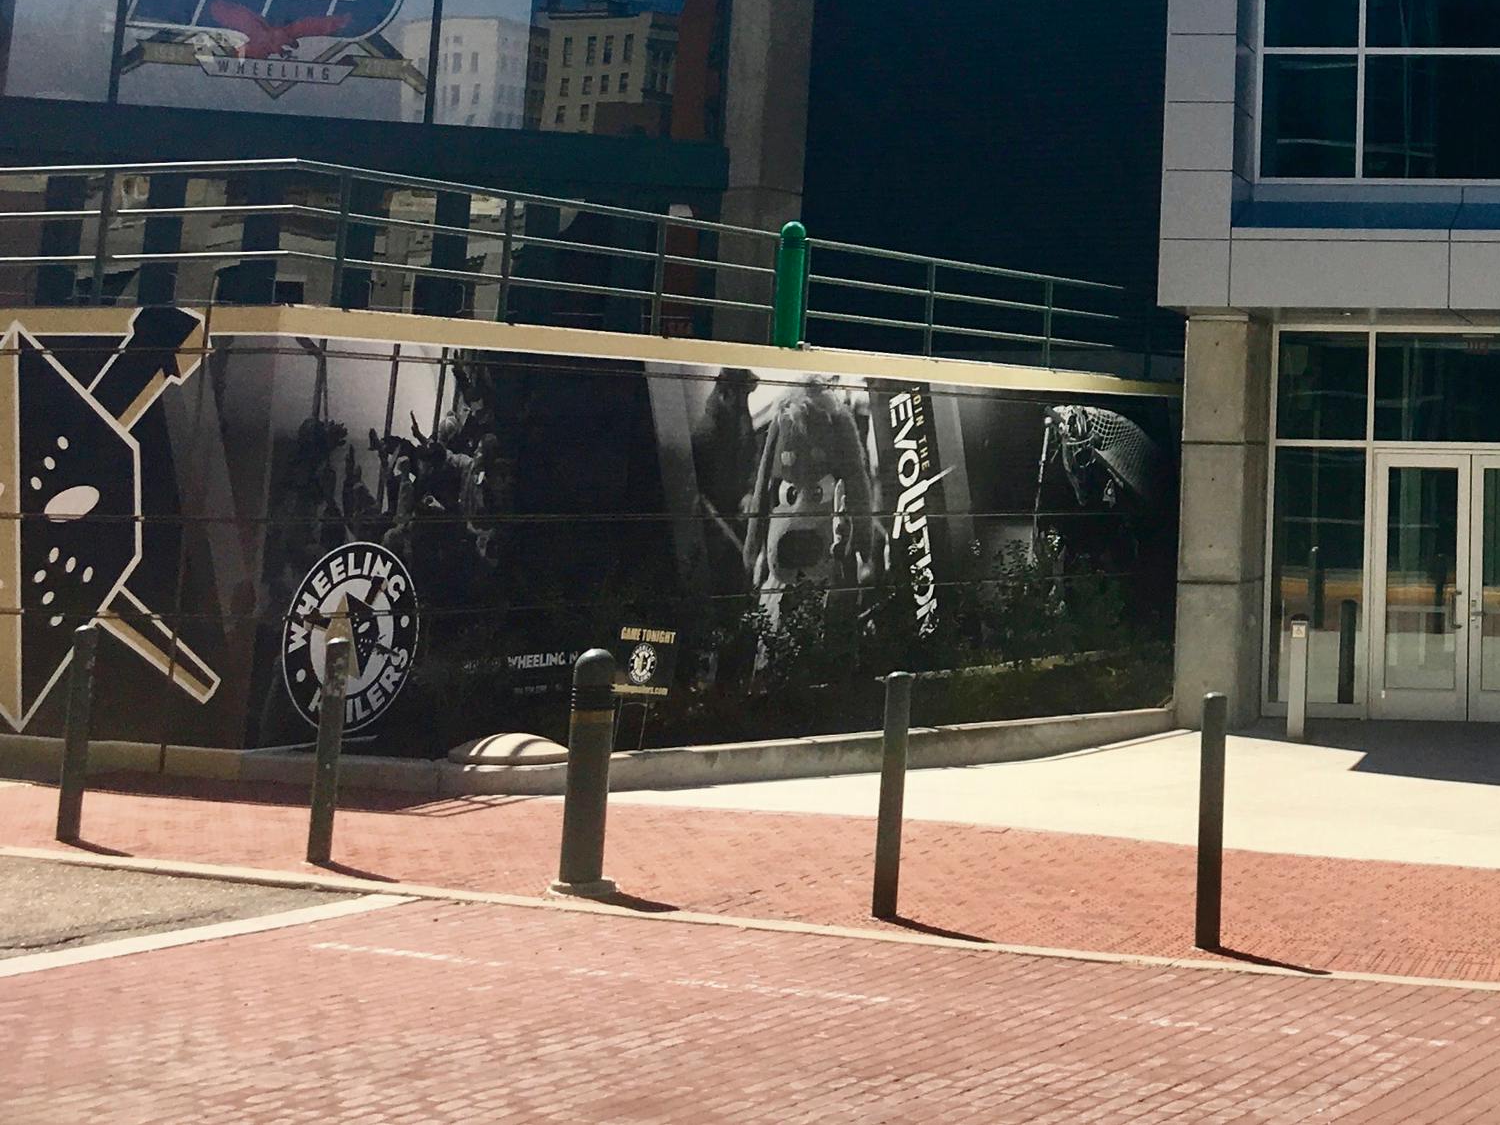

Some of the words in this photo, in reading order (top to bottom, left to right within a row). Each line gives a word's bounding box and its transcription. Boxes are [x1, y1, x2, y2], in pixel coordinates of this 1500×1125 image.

[217, 59, 331, 82] WHEELING
[918, 435, 931, 472] THE
[287, 551, 407, 654] WHEELING
[620, 626, 642, 641] GAME
[642, 627, 678, 644] TONIGHT
[507, 651, 566, 669] WHEELING
[307, 646, 409, 724] ILERS
